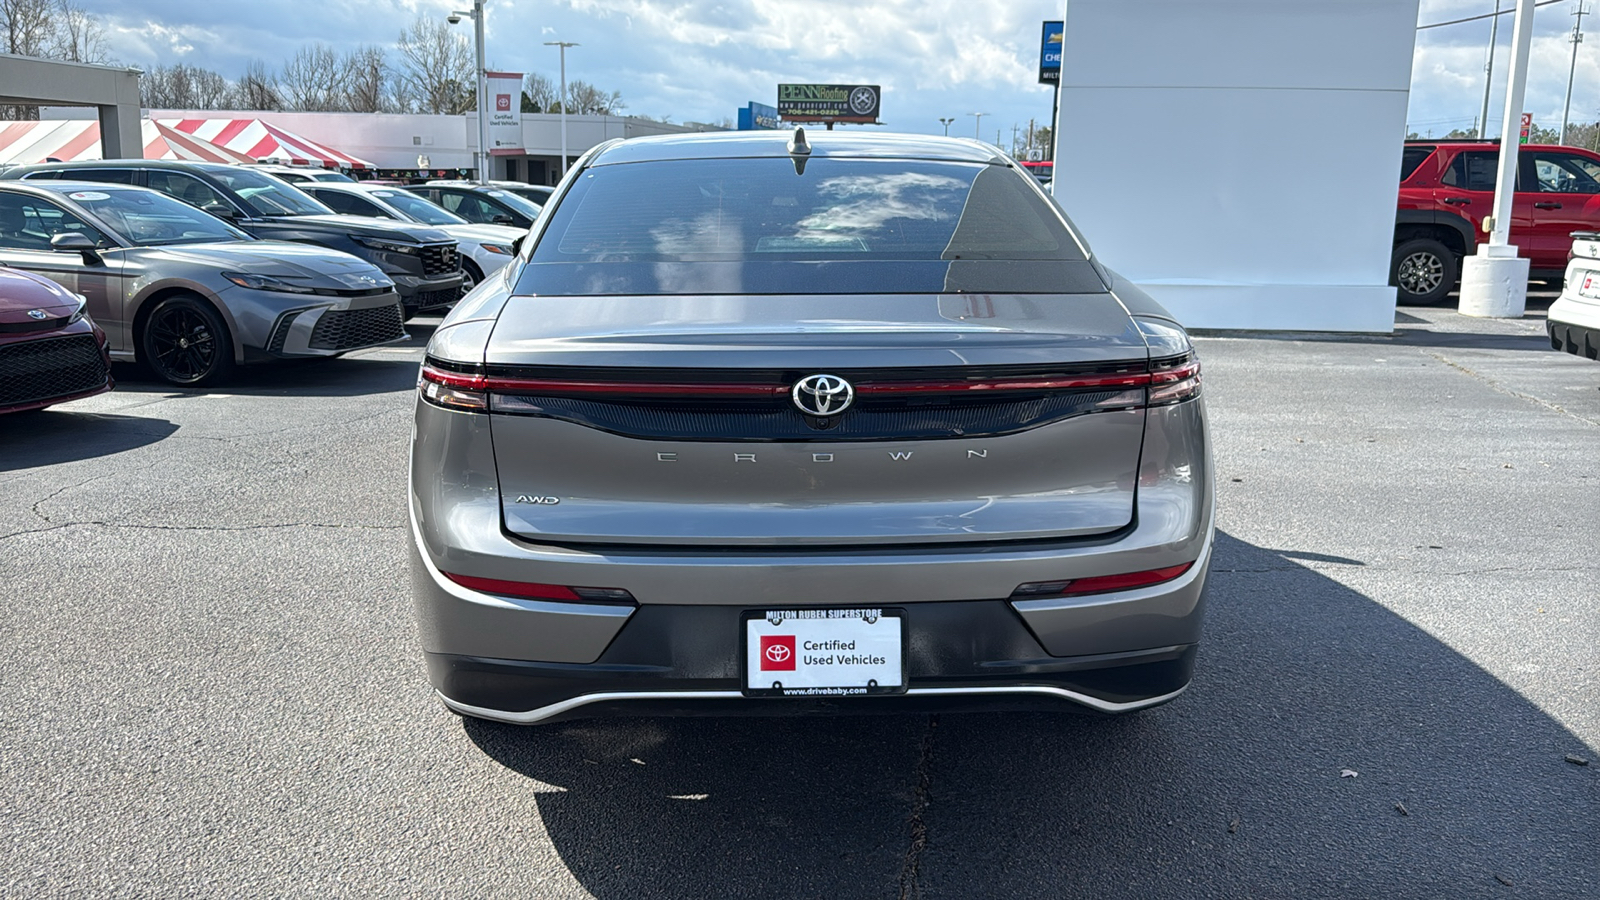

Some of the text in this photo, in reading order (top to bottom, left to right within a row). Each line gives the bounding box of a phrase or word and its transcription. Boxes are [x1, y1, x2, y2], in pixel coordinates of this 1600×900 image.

[780, 85, 821, 99] PENN
[820, 87, 848, 102] Roofing
[515, 495, 560, 505] AWD
[766, 609, 883, 620] MILTON RUBEN SUPERSTORE
[803, 640, 856, 651] Certified
[803, 655, 886, 665] Used Vehicles
[783, 687, 868, 696] www.drivebaby.com
